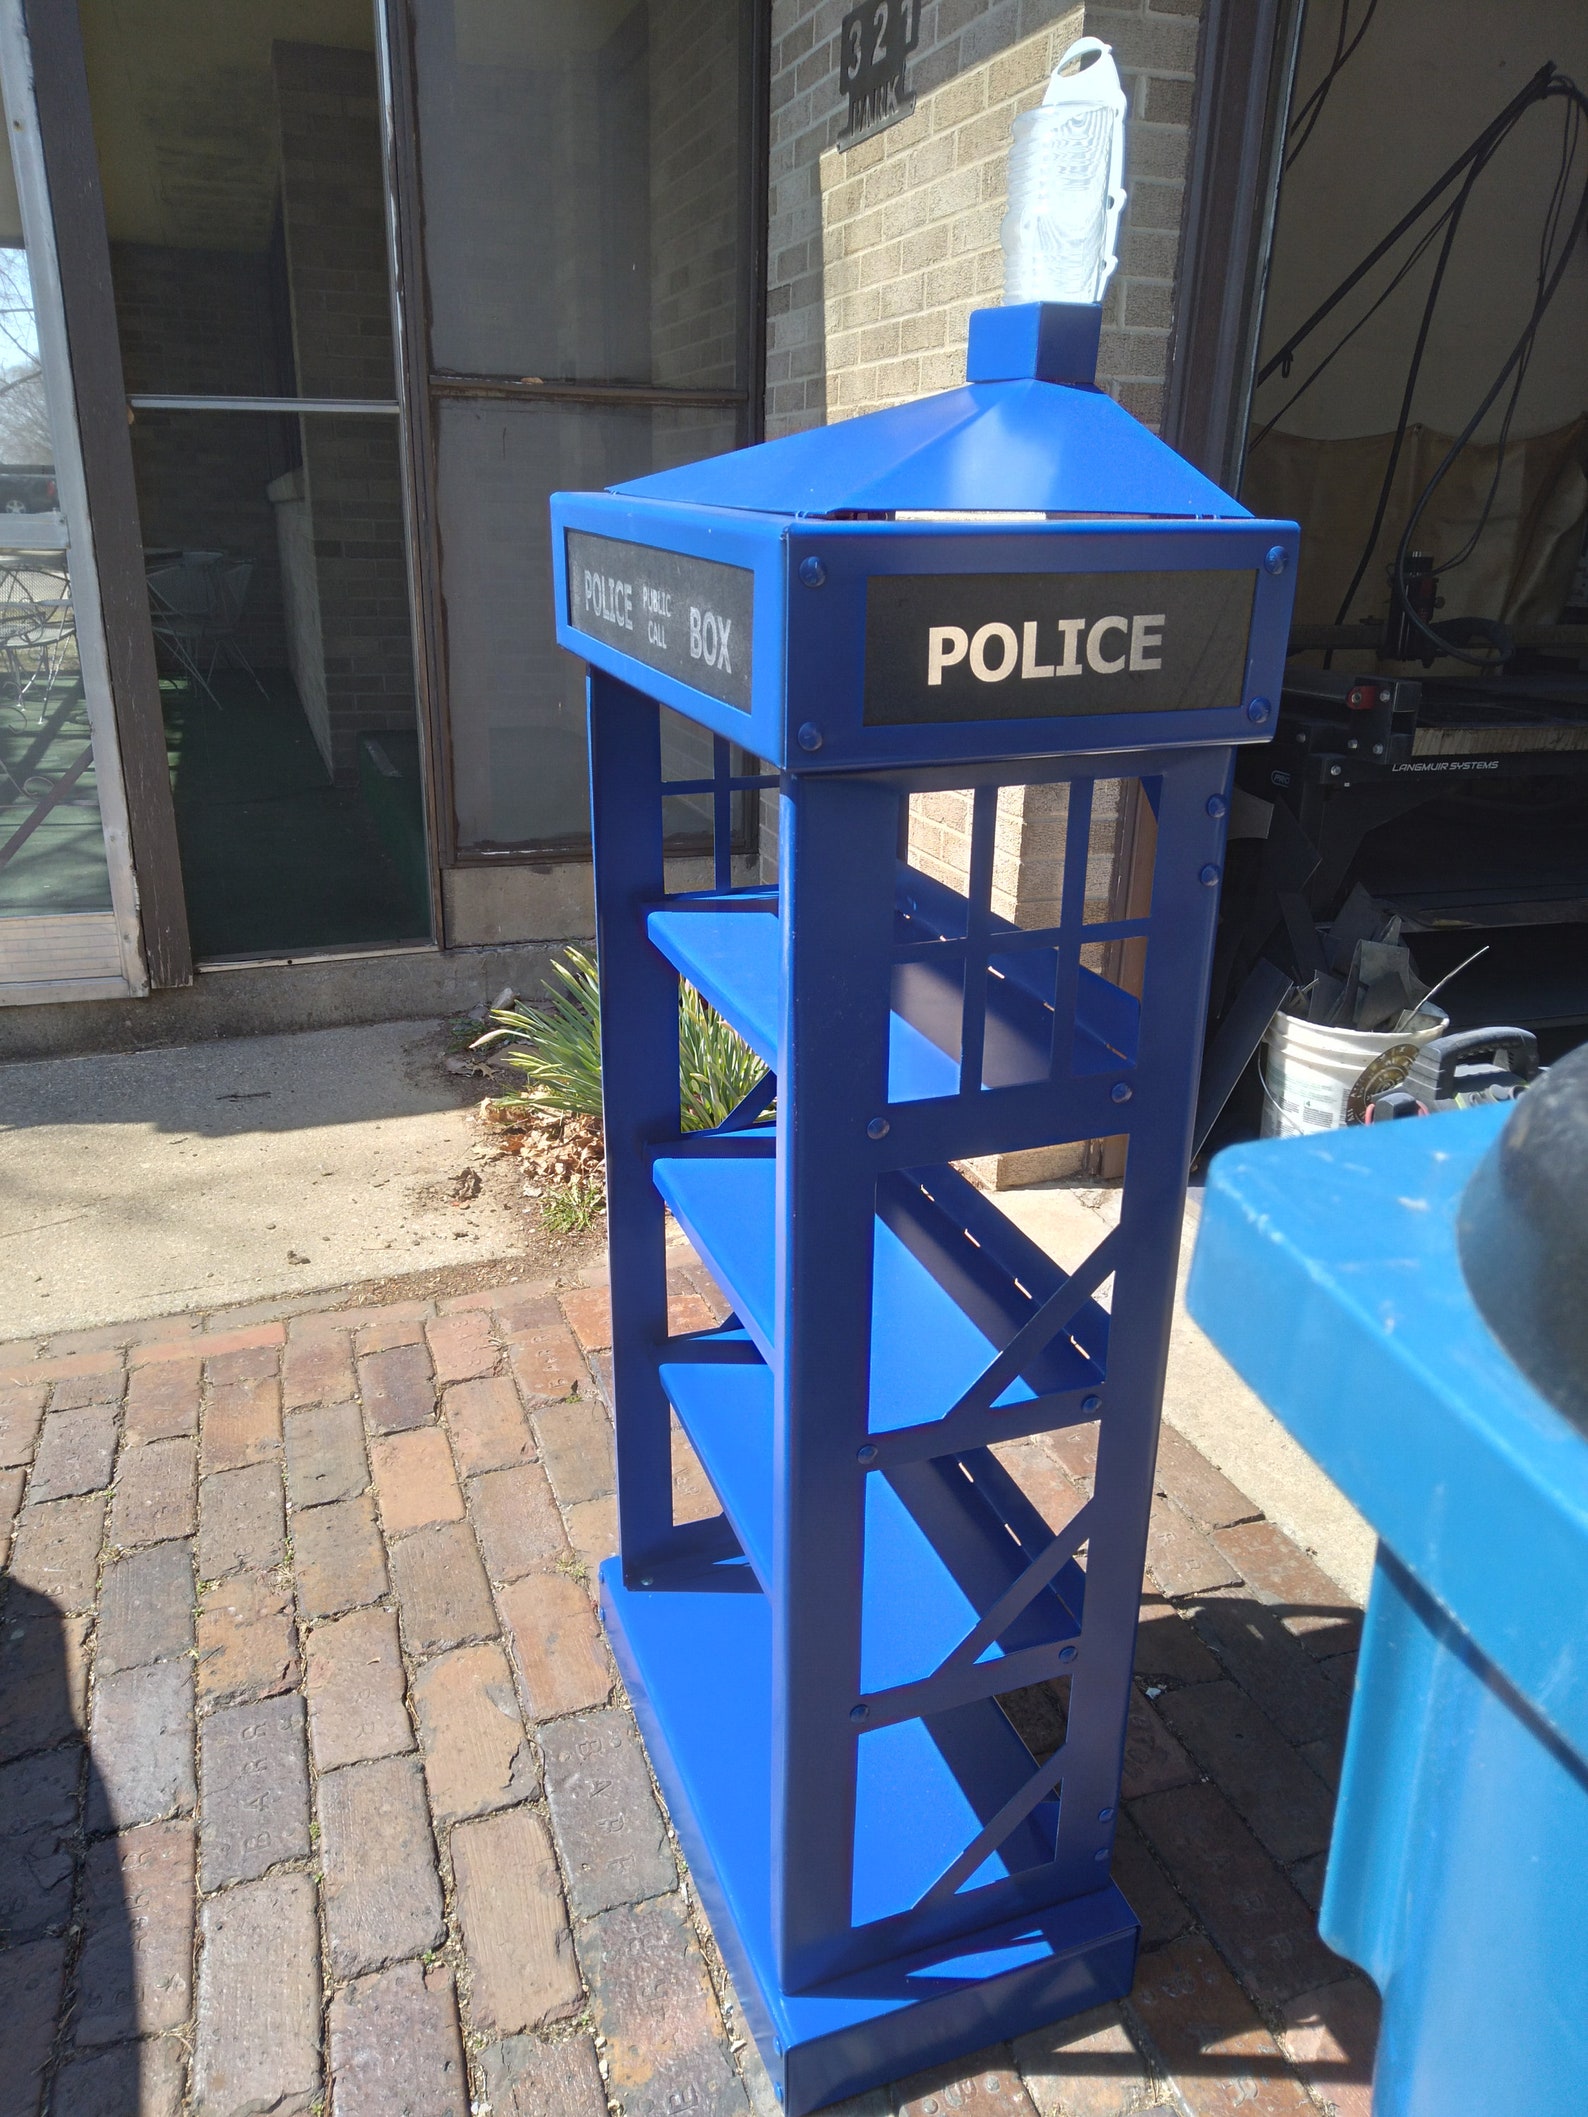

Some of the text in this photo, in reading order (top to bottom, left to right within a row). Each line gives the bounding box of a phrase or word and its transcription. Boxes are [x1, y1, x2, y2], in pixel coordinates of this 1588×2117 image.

[847, 0, 914, 80] 321
[584, 569, 732, 675] POLICE PUBLIC BOX
[647, 620, 668, 649] CALL
[927, 613, 1166, 686] POLICE
[1392, 760, 1500, 772] LANGMUIR SYSTEMS
